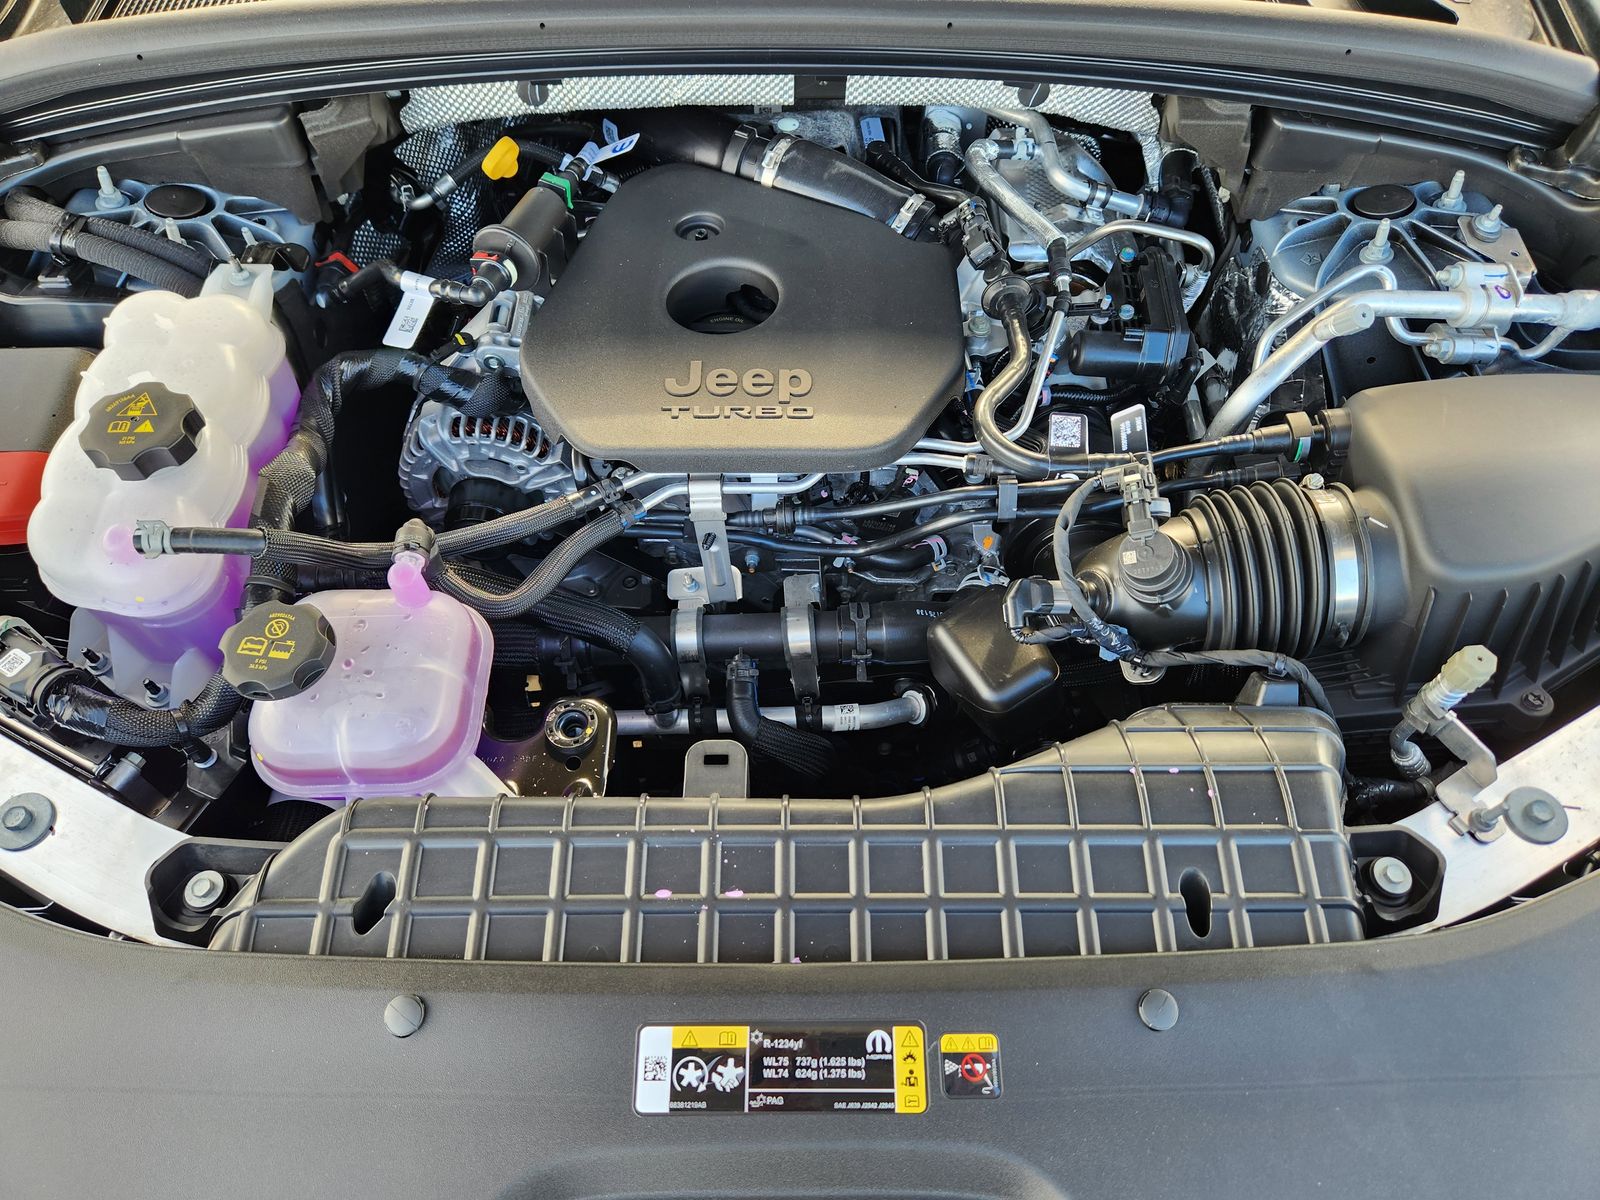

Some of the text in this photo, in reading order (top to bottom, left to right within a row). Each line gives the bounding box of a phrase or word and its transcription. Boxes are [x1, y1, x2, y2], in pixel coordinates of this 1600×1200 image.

[664, 360, 813, 404] Jeep
[661, 405, 814, 419] TURBO
[763, 1038, 803, 1051] R-1234yf
[763, 1056, 866, 1068] WL75 737g (1.625 lbs)
[763, 1068, 866, 1080] WL74 624g (1.375 lbs)
[766, 1096, 784, 1105] PAG
